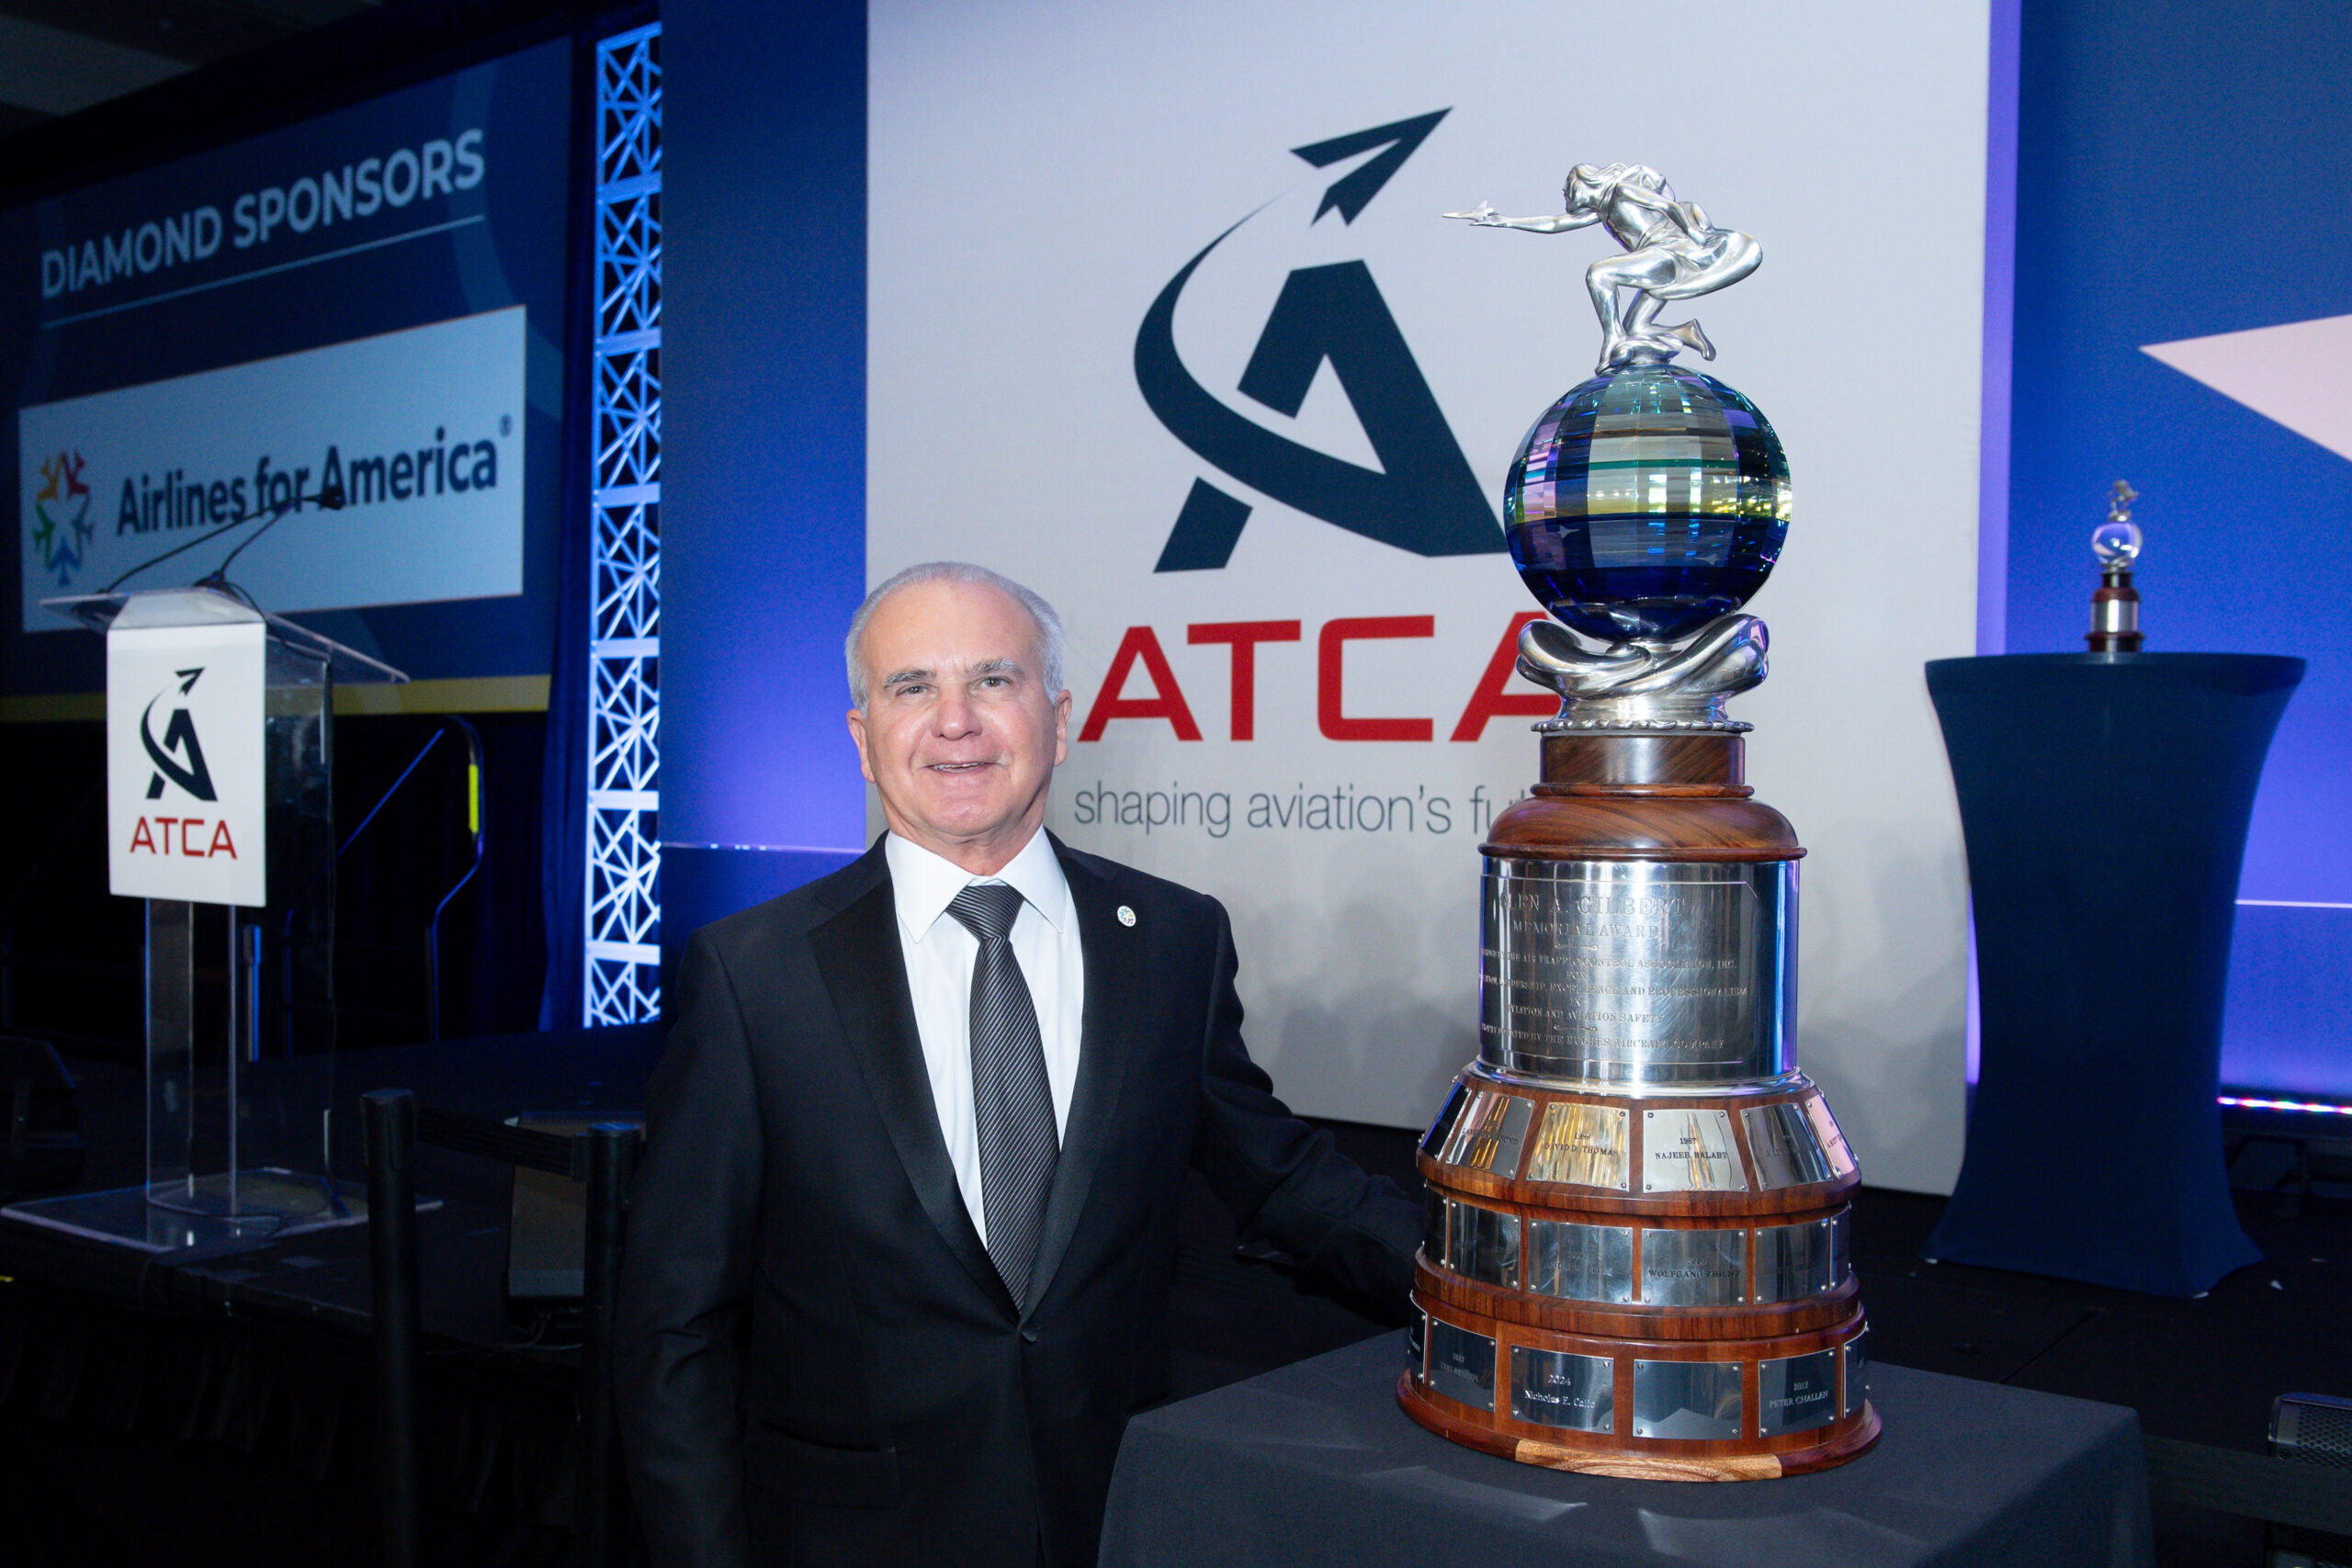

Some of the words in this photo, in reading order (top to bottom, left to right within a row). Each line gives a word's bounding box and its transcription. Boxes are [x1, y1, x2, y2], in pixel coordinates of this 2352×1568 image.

[41, 206, 222, 299] DIAMOND
[232, 128, 485, 248] SPONSORS
[117, 468, 247, 536] Airlines
[255, 457, 309, 514] for
[1077, 611, 1563, 742] ATCA
[1074, 781, 1231, 838] shaping
[1247, 784, 1452, 834] aviation's
[130, 816, 237, 860] ATCA
[1577, 896, 1685, 917] GILBERT
[1513, 920, 1594, 936] MEMORIAL
[1600, 923, 1659, 938] AWARD
[1623, 986, 1645, 996] AND
[1566, 1010, 1617, 1022] AVIATION
[1620, 1013, 1665, 1023] SAFETY
[1544, 1143, 1569, 1152] DAVID
[1582, 1145, 1619, 1156] THOMAS
[1679, 1137, 1697, 1145] 1987
[1648, 1269, 1703, 1279] WOLFGANG
[1547, 1374, 1571, 1386] 2024
[1524, 1390, 1560, 1404] Nicholas
[1562, 1395, 1572, 1406] E.
[1770, 1397, 1794, 1409] PETER
[1795, 1390, 1828, 1405] CHALLAN
